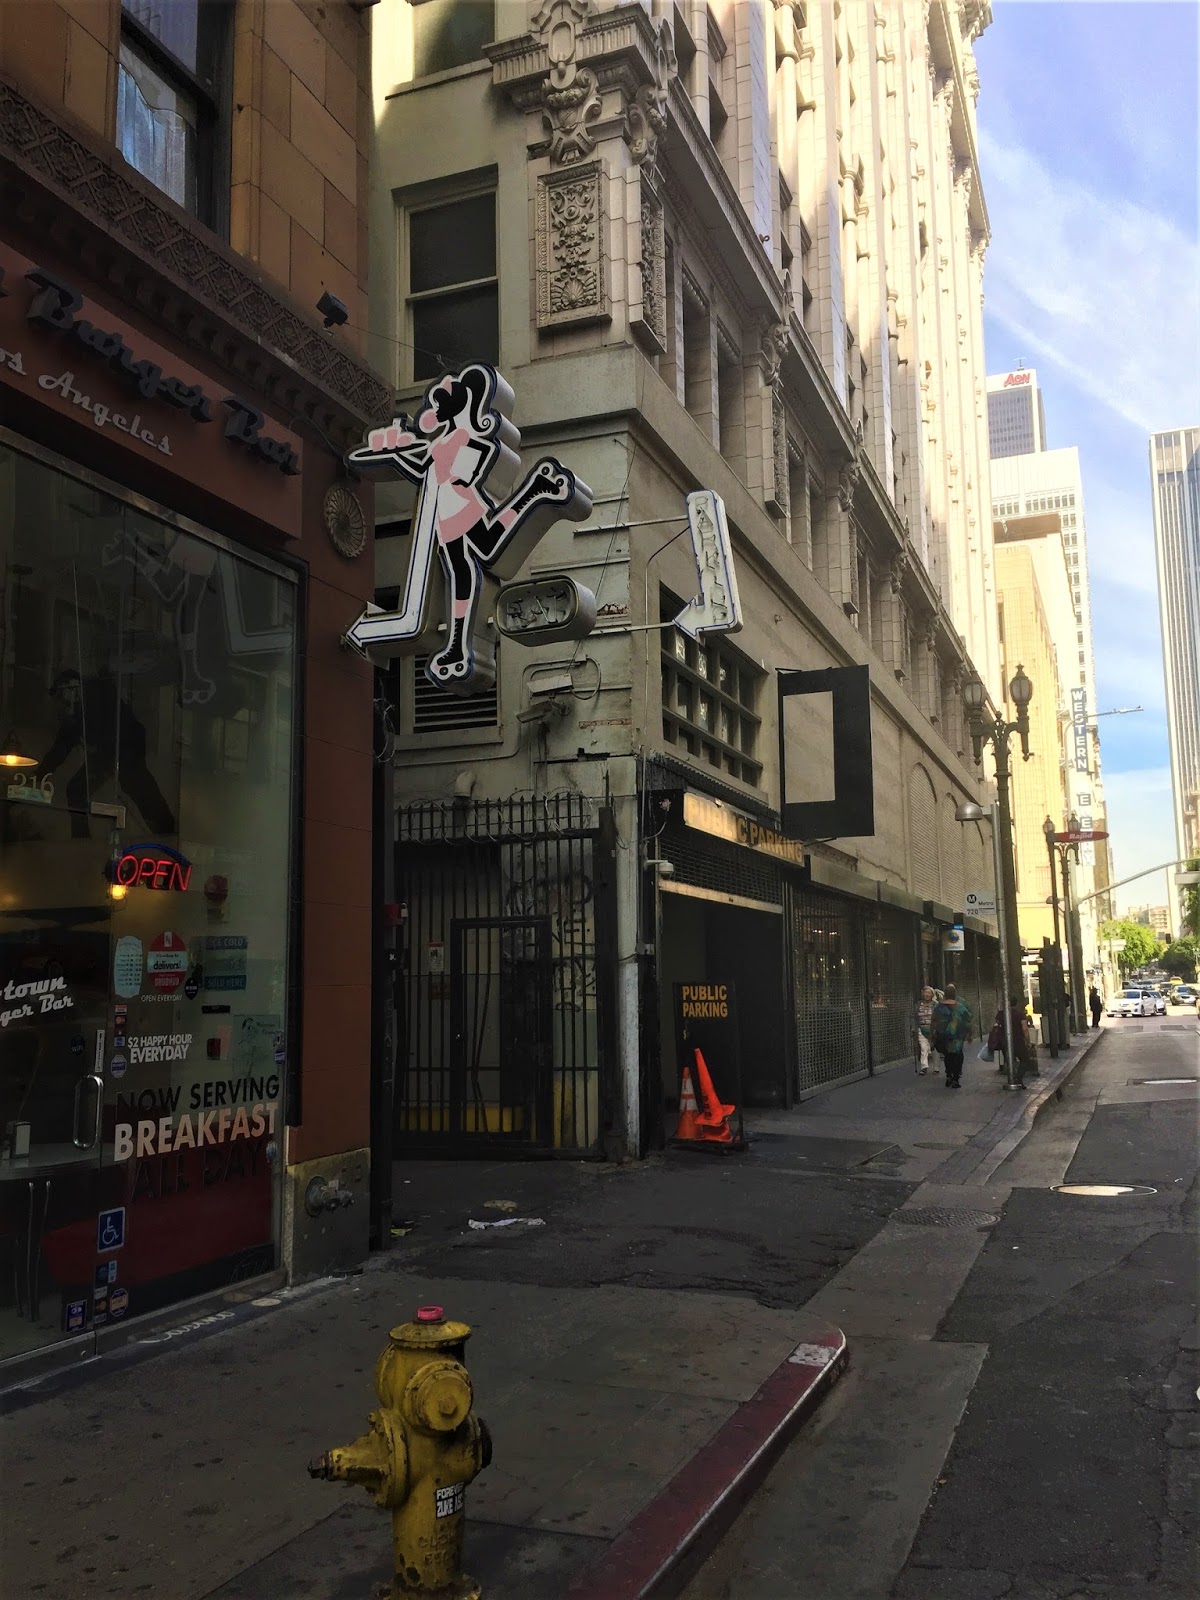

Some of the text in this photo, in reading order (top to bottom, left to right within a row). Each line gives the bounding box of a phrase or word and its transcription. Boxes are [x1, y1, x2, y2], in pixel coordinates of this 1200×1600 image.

[25, 268, 300, 476] Burger Bar
[38, 371, 173, 456] Angeles
[1071, 688, 1089, 771] WESTERN
[13, 772, 55, 798] 216
[687, 795, 804, 862] PUBLIC PARKING
[1069, 832, 1093, 840] Rapid
[116, 854, 192, 891] OPEN
[224, 937, 244, 947] COLD
[141, 994, 183, 1003] OPEN EVERYDAY
[682, 984, 728, 1001] PUBLIC
[0, 994, 74, 1027] ger Bar
[682, 1002, 729, 1018] PARKING
[127, 1034, 193, 1049] $2 HAPPY HOUR
[130, 1044, 191, 1064] EVERYDAY
[116, 1075, 280, 1113] NOW SERVING
[114, 1102, 279, 1162] BREAKFAST
